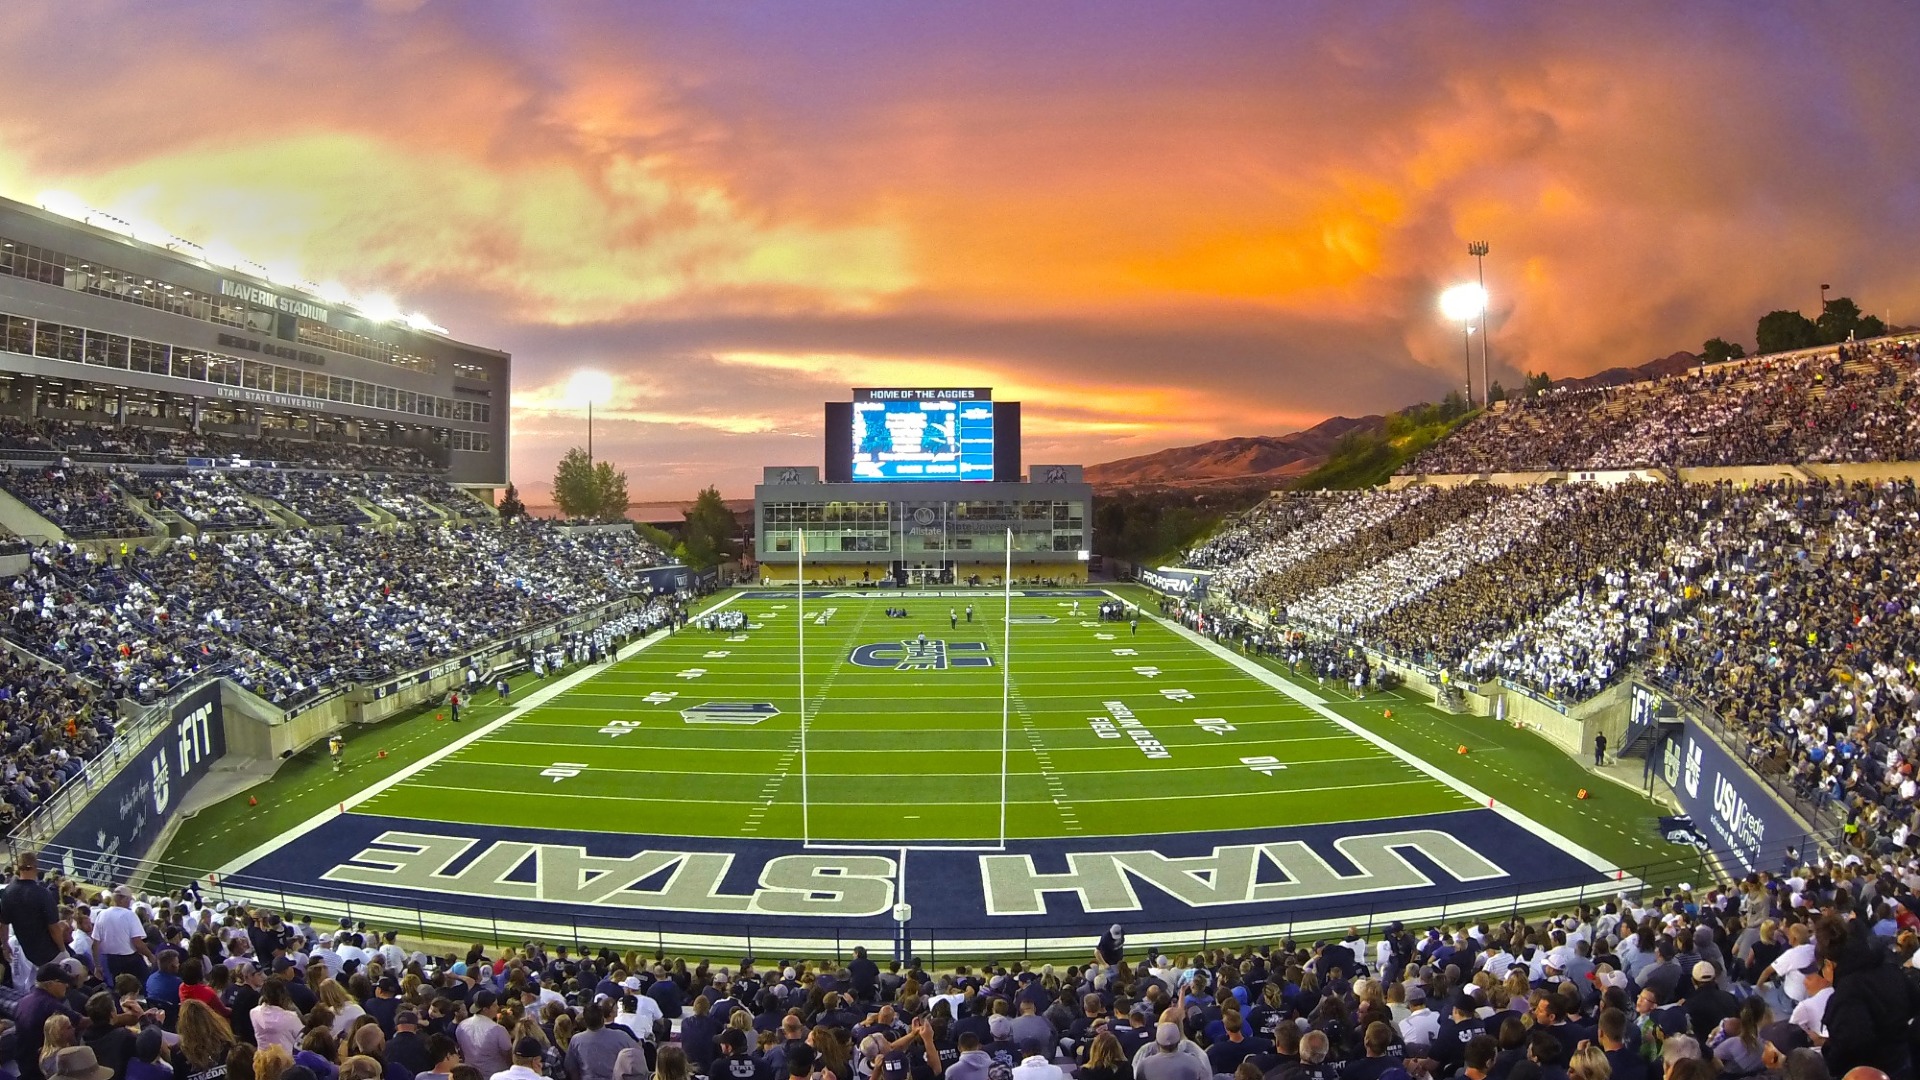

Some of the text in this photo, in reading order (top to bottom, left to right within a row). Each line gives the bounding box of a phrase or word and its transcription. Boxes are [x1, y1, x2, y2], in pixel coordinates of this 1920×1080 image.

[222, 279, 328, 323] MAVERIK STADIUM
[217, 387, 325, 410] UTAH STATE UNIVERSITY
[870, 390, 975, 399] HOME OF THE AGGIES
[909, 526, 942, 536] Allstate
[597, 720, 642, 733] 20
[1087, 716, 1122, 739] FIELD
[1101, 701, 1172, 759] MERLIN OLSEN
[1193, 717, 1237, 732] 20
[178, 701, 213, 778] iFIT
[540, 763, 590, 777] 10
[1239, 756, 1288, 771] 10
[1713, 771, 1743, 833] USU
[1741, 802, 1765, 841] Credit
[1738, 818, 1761, 858] Union
[320, 828, 1510, 917] UTAH STATE
